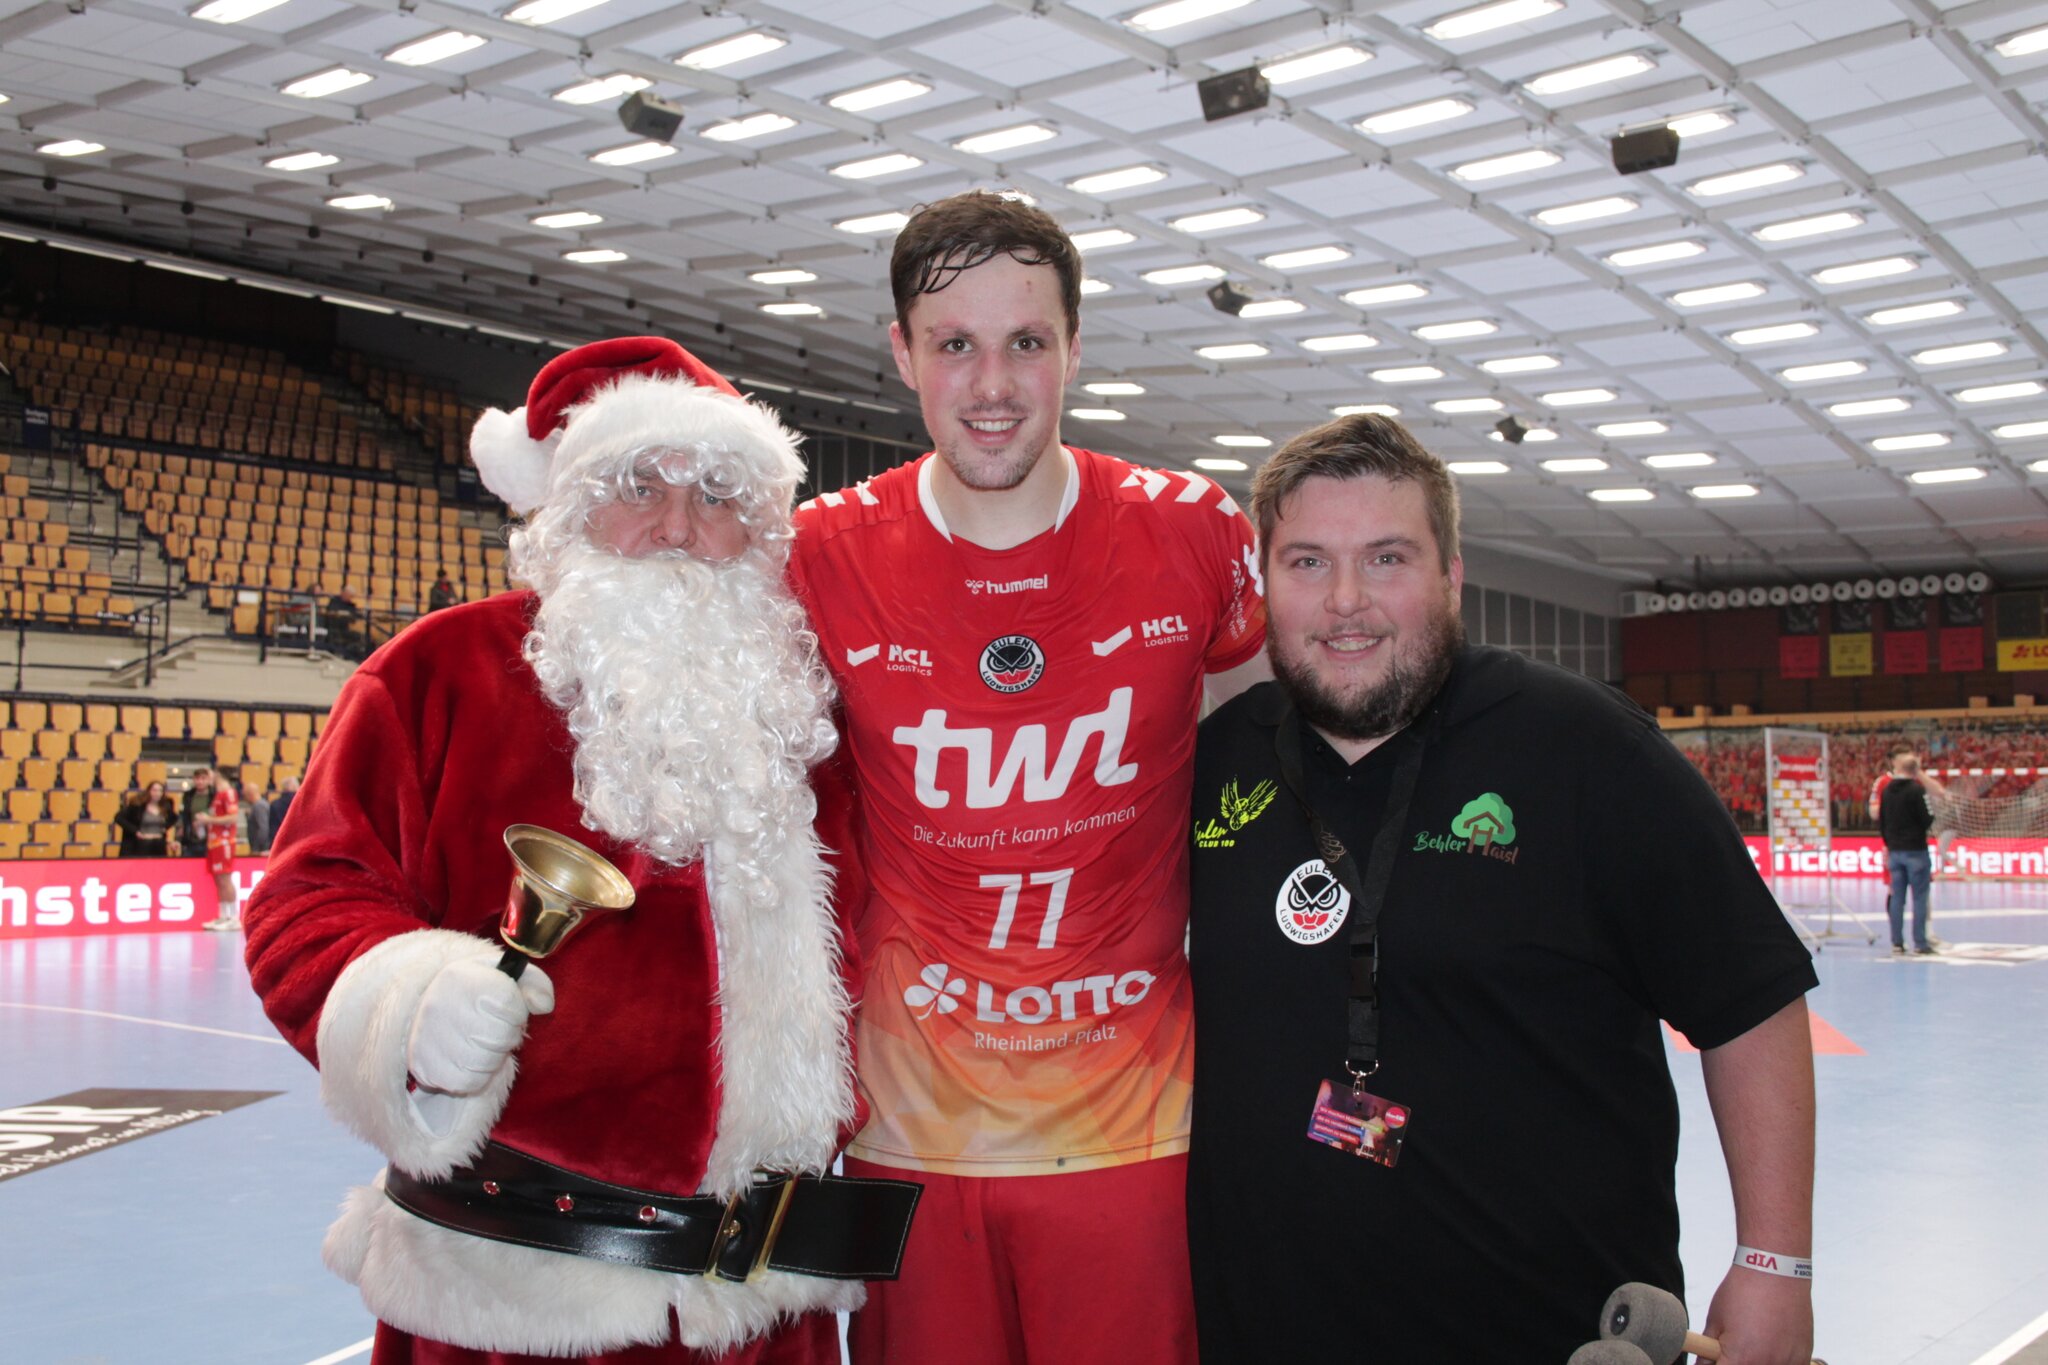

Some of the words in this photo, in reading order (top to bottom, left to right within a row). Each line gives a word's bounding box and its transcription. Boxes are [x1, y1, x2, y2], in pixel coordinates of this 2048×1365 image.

[986, 574, 1048, 594] hummel
[1141, 615, 1188, 638] HCL
[991, 637, 1030, 651] EULEN
[1145, 634, 1189, 648] LOGISTICS
[888, 644, 933, 667] HCL
[887, 664, 932, 676] LOGISTICS
[982, 664, 1042, 691] LUDWIGSHAFEN
[913, 825, 934, 844] Die
[936, 829, 1007, 851] Zukunft
[1012, 827, 1058, 844] kann
[1064, 806, 1136, 837] kommen
[1199, 840, 1219, 848] CLUB
[1221, 840, 1235, 848] 100
[1297, 864, 1337, 880] EULE
[979, 868, 1074, 950] 77
[1280, 908, 1344, 940] LUDWIGSHAFEN
[977, 970, 1156, 1024] LOTTO
[975, 1024, 1117, 1051] Rheinland-Pfalz
[1745, 1253, 1777, 1270] VIP
